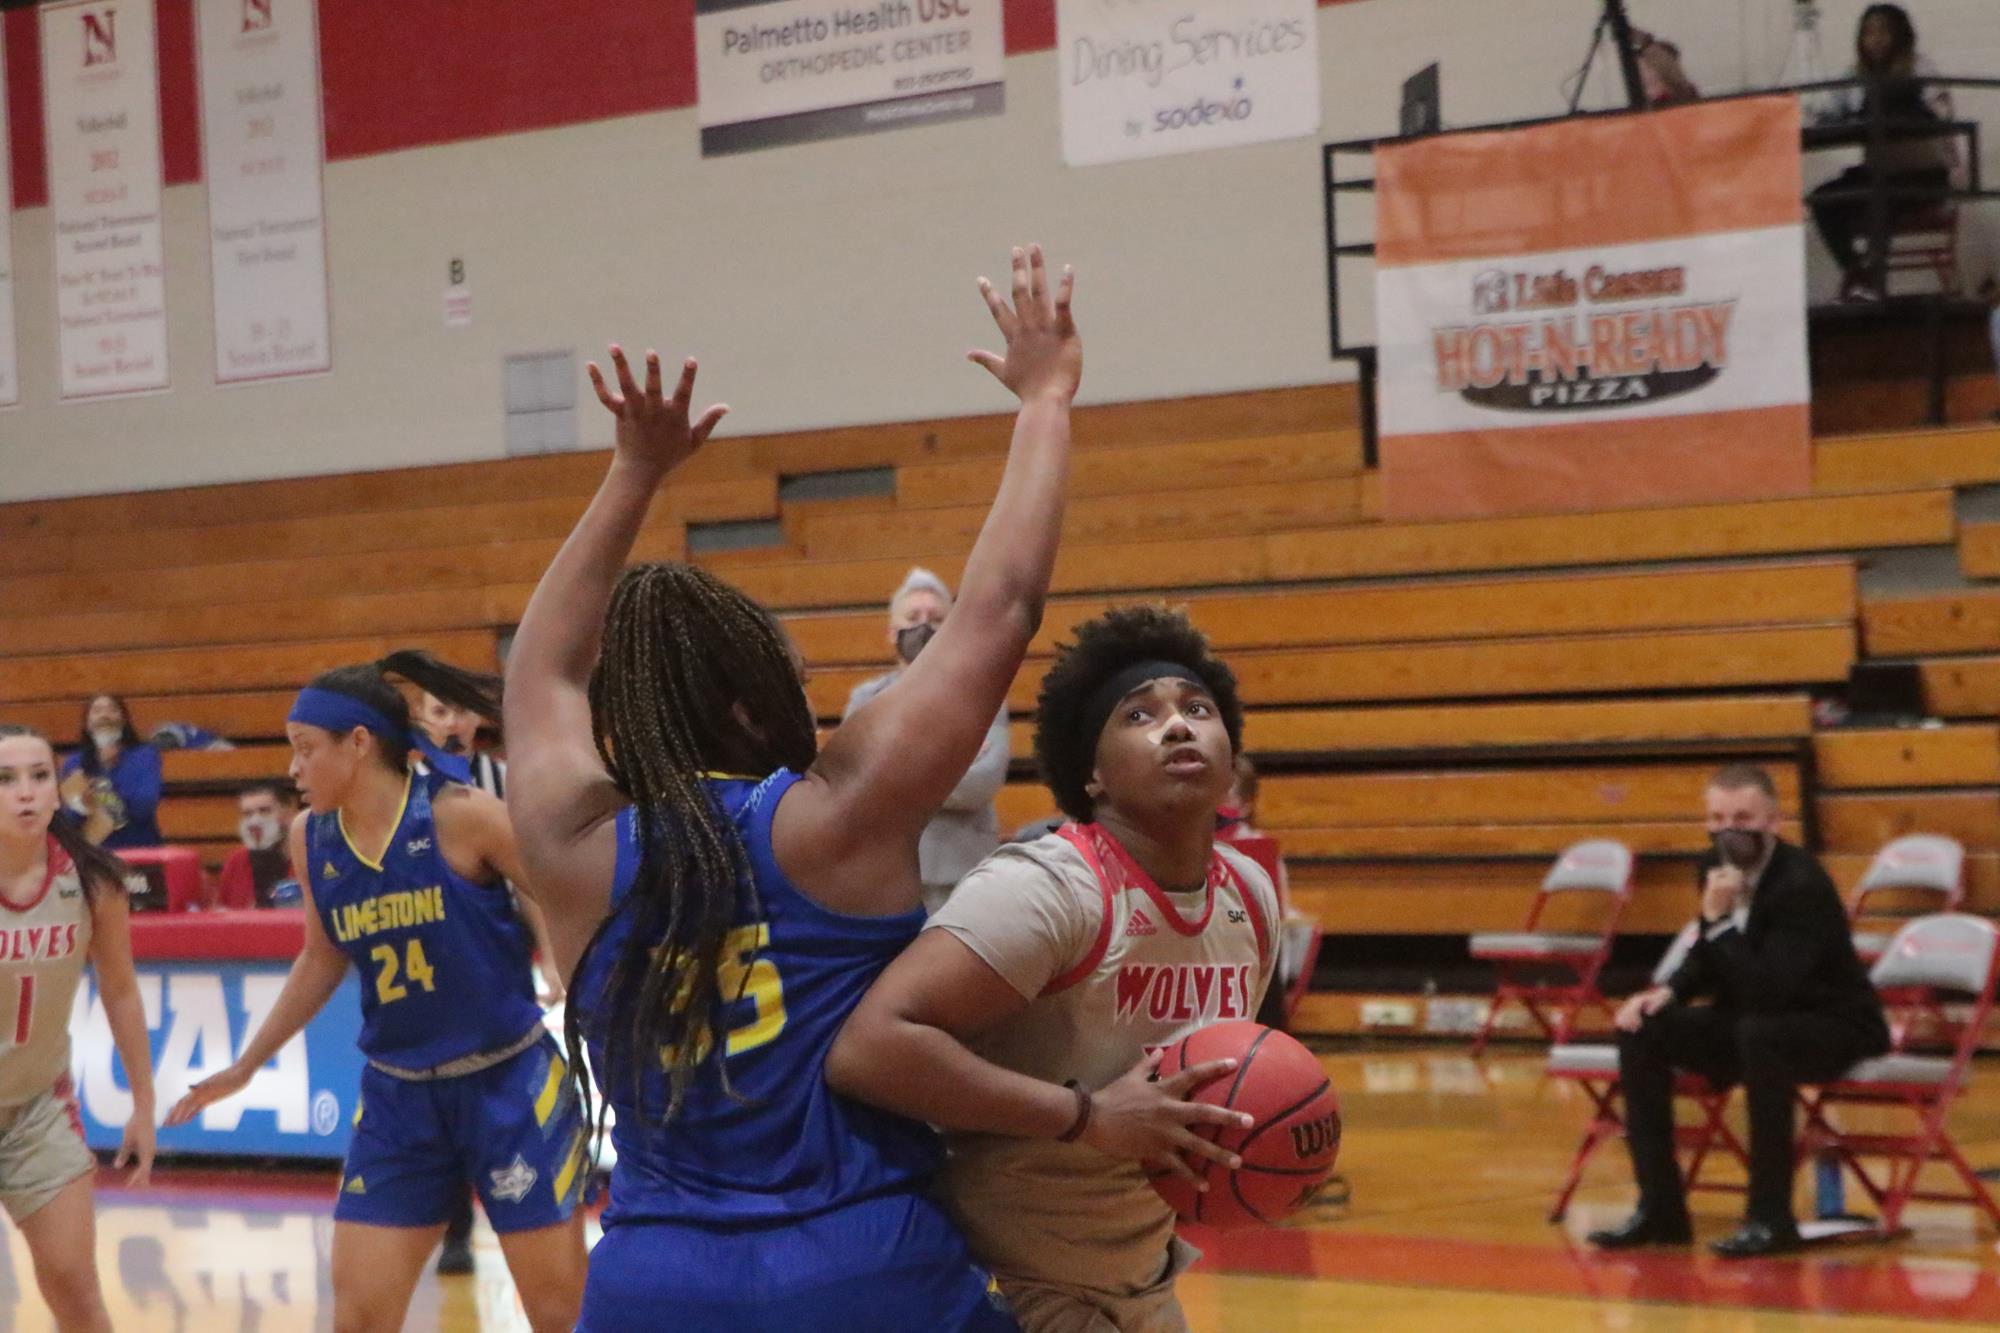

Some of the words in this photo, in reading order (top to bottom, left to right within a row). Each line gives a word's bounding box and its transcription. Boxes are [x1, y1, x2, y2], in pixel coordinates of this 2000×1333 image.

[724, 18, 828, 55] Palmetto
[834, 3, 912, 36] Health
[1073, 37, 1163, 88] Dining
[1168, 14, 1306, 72] Services
[761, 44, 886, 83] ORTHOPEDIC
[892, 30, 972, 61] CENTER
[1154, 99, 1253, 131] sodexo
[450, 258, 466, 285] B
[1432, 299, 1740, 391] HOT-N-READY
[1531, 378, 1649, 406] PIZZA
[1227, 909, 1246, 924] SAC
[371, 939, 436, 1005] 24
[1114, 961, 1252, 1025] WOLVES
[14, 973, 37, 1047] 1
